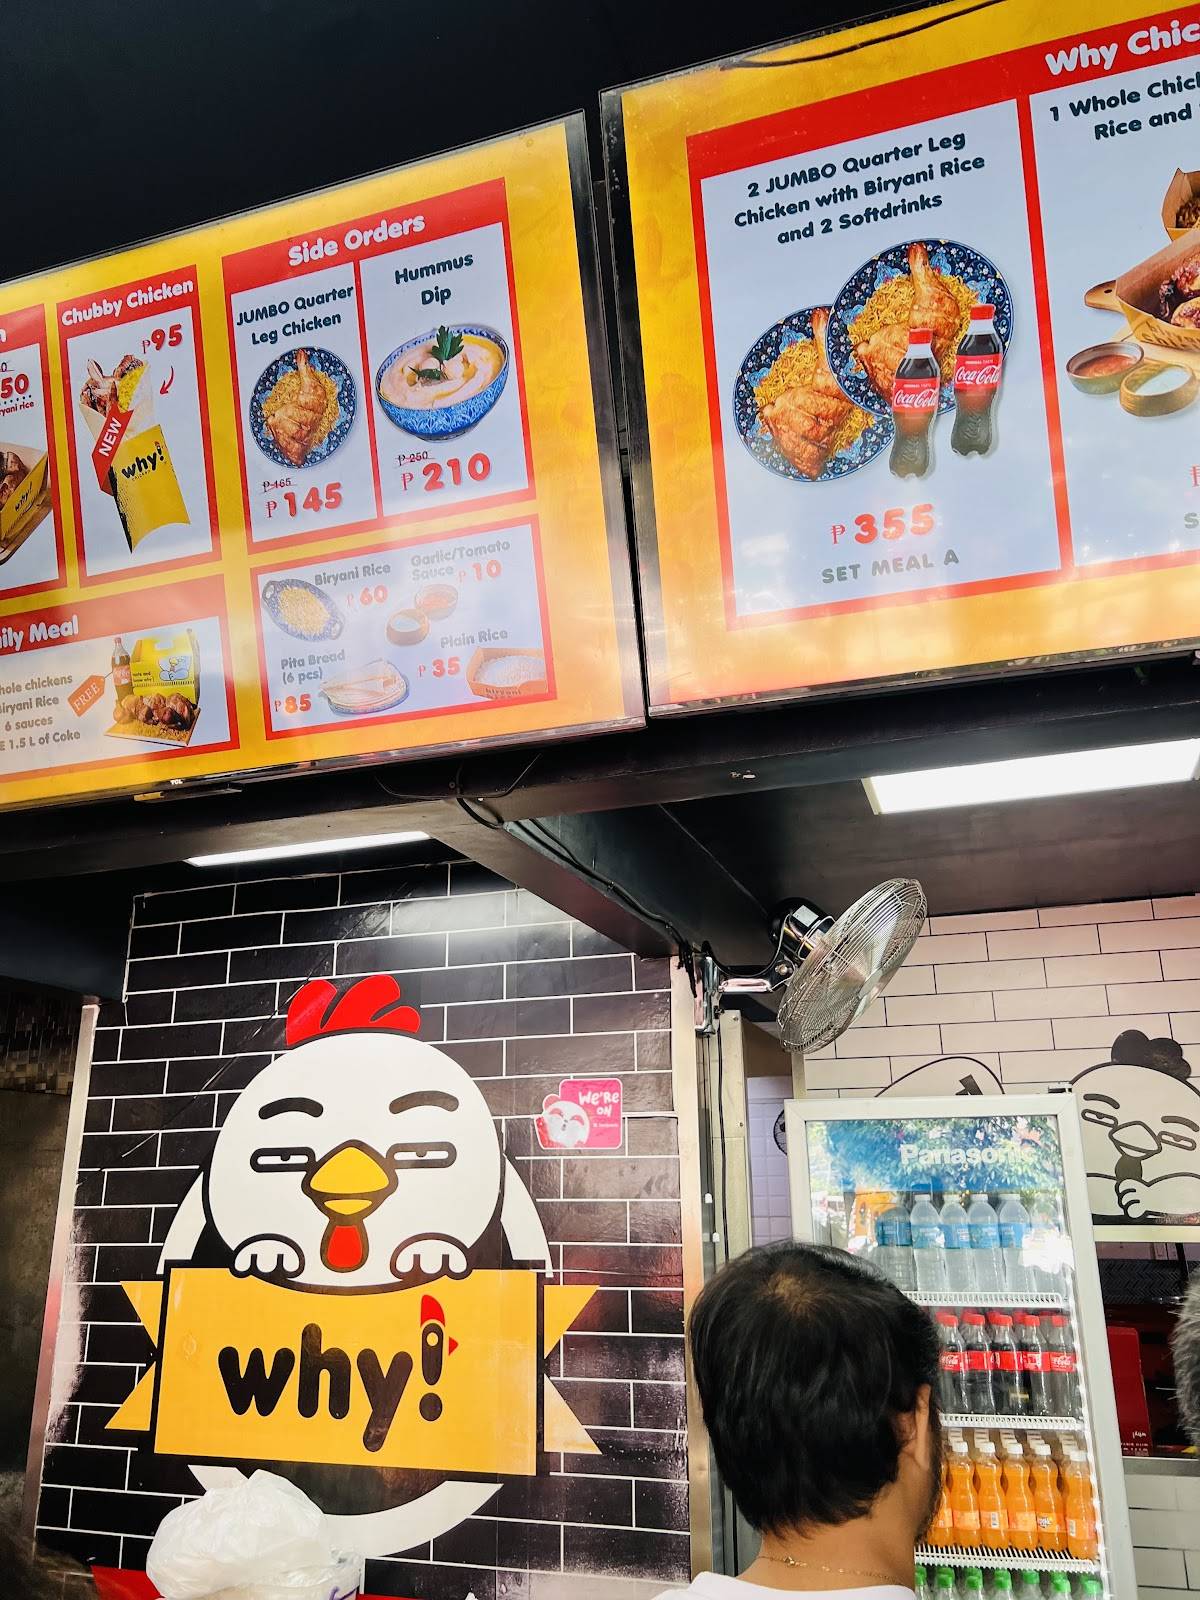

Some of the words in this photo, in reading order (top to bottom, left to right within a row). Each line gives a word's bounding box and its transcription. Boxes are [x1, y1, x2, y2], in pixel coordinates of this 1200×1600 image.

[1045, 43, 1118, 75] Why
[1127, 20, 1200, 55] Chic
[1050, 107, 1059, 121] 1
[1069, 89, 1141, 116] Whole
[1094, 119, 1142, 140] Rice
[1149, 103, 1192, 127] and
[747, 182, 759, 197] 2
[766, 162, 837, 193] JUMBO
[842, 143, 922, 173] Quarter
[929, 132, 966, 152] Leg
[734, 200, 810, 227] Chicken
[816, 185, 858, 207] with
[864, 164, 934, 197] Biryani
[940, 157, 985, 178] Rice
[777, 222, 814, 244] and
[820, 218, 833, 234] 2
[839, 193, 943, 229] Softdrinks
[288, 237, 338, 266] Side
[344, 214, 425, 250] Orders
[394, 254, 474, 285] Hummus
[61, 297, 122, 326] Chubby
[126, 278, 194, 309] Chicken
[236, 300, 290, 326] JUMBO
[294, 285, 354, 310] Quarter
[421, 285, 452, 305] Dip
[251, 326, 278, 345] Leg
[282, 311, 342, 337] Chicken
[955, 365, 1001, 385] Coca-Cola
[19, 401, 34, 411] rice
[894, 389, 938, 408] Coca-Cola
[99, 417, 122, 457] NEW
[121, 441, 164, 479] why!
[410, 539, 511, 568] Garlic/Tomato
[821, 563, 861, 584] SET
[871, 553, 934, 576] MEAL
[943, 549, 960, 566] A
[314, 566, 359, 587] Biryani
[363, 563, 391, 577] Rice
[411, 566, 454, 581] Sauce
[0, 627, 24, 652] ily
[29, 614, 79, 643] Meal
[440, 634, 475, 649] Plain
[478, 627, 508, 643] Rice
[281, 656, 305, 670] Pita
[309, 649, 345, 666] Bread
[25, 675, 73, 691] chickens
[282, 672, 295, 685] (6
[298, 667, 323, 683] pcs)
[35, 696, 60, 708] Rice
[74, 682, 100, 711] FREE
[4, 721, 12, 732] 6
[15, 717, 53, 730] sauces
[9, 737, 26, 750] 1.5
[29, 737, 36, 747] L
[38, 733, 50, 745] of
[53, 729, 81, 743] Coke
[900, 1143, 1036, 1165] Panasonic
[218, 1320, 443, 1452] why!
